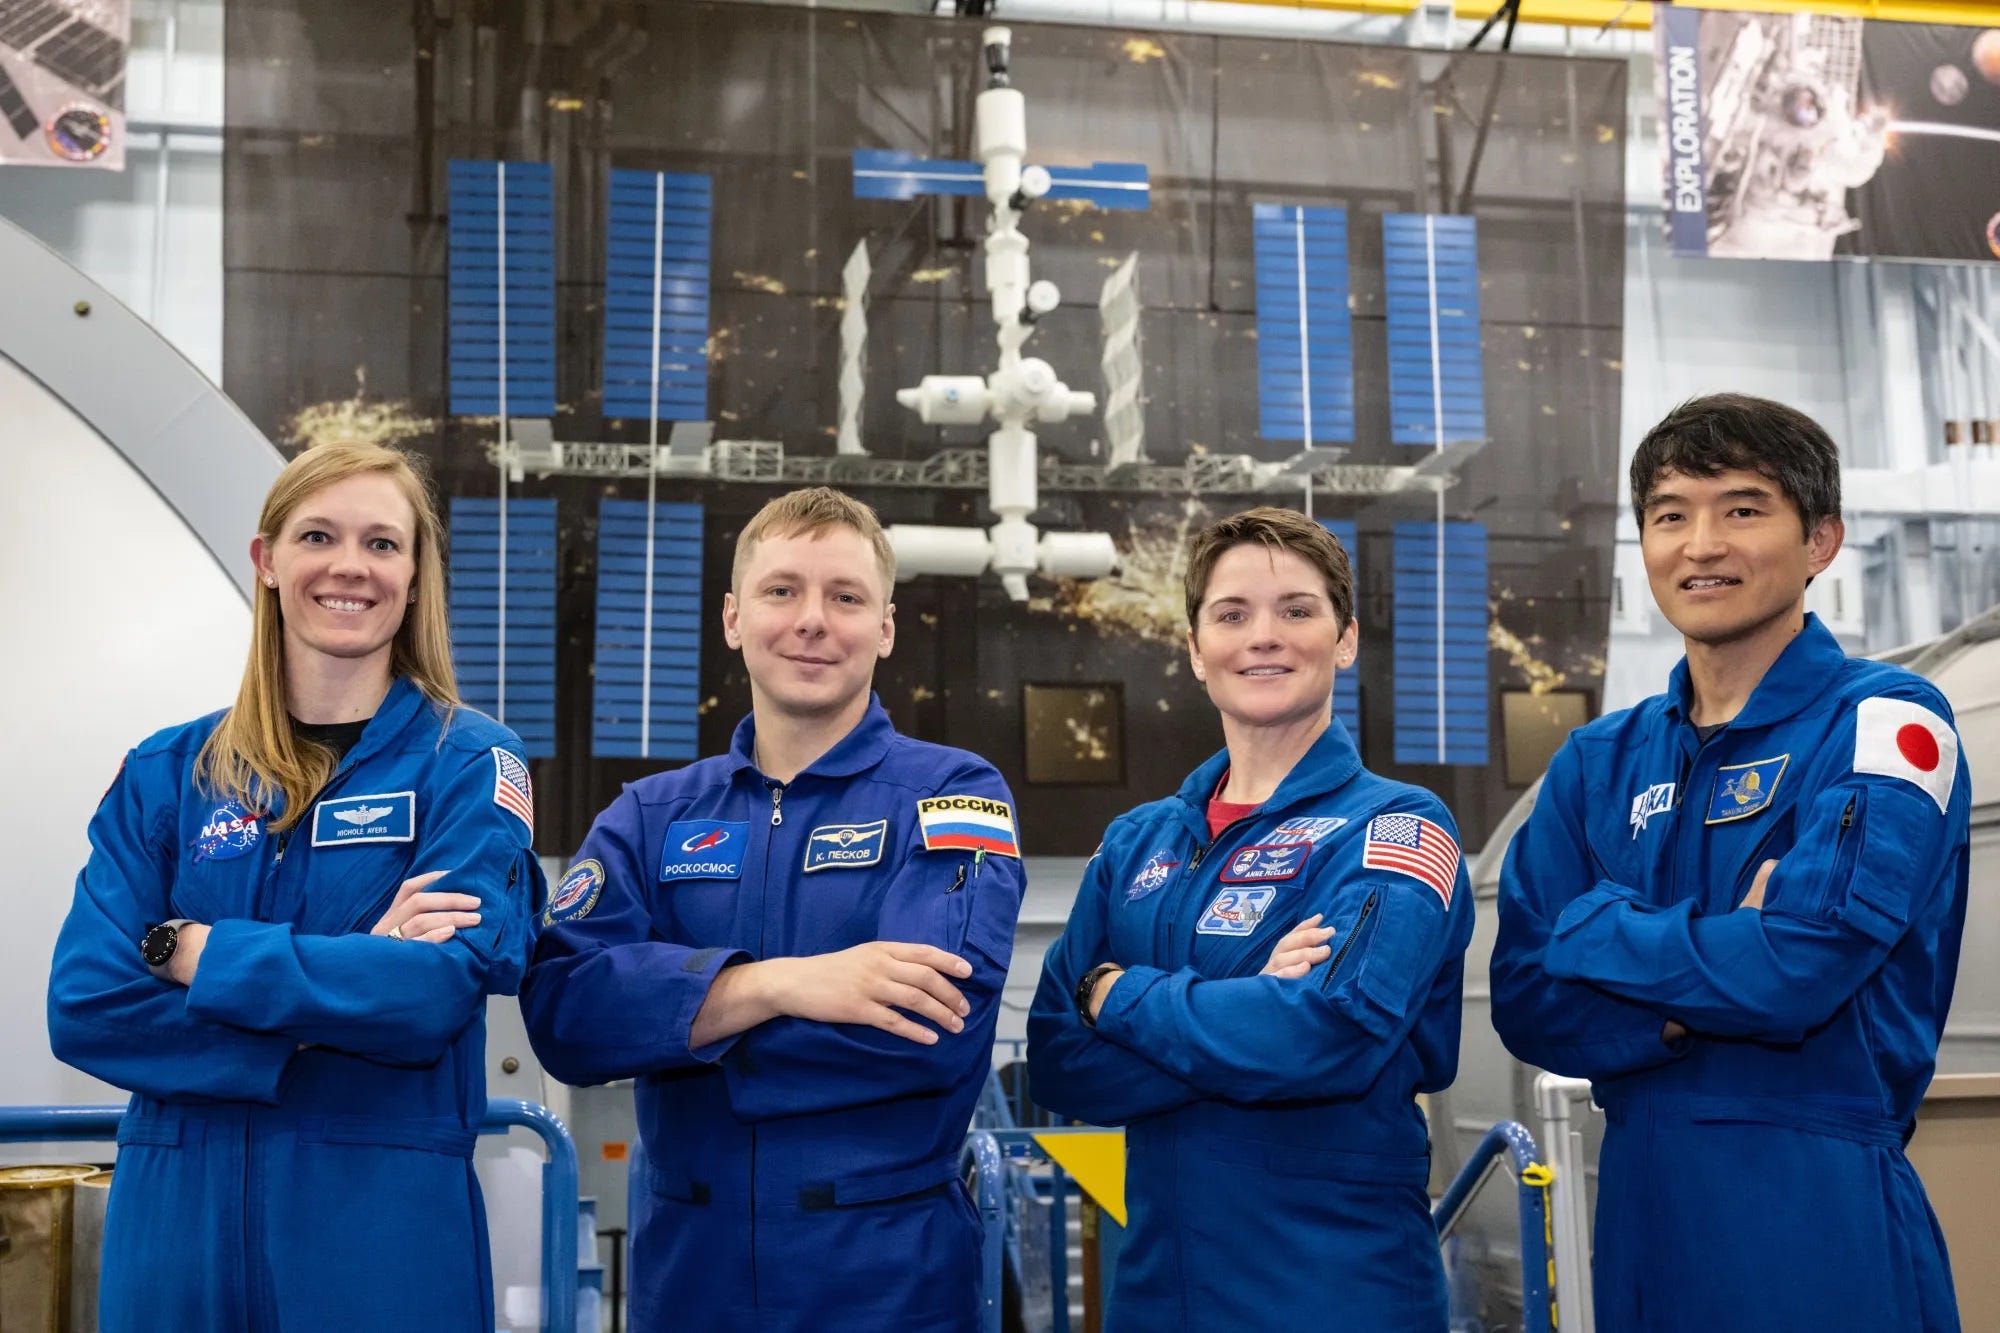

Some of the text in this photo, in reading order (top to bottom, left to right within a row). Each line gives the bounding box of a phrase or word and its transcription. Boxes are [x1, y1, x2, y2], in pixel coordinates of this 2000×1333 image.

[1669, 46, 1702, 212] EXPLORATION
[922, 798, 1008, 818] РОССИЯ
[200, 818, 260, 839] NASA
[336, 826, 388, 838] NICHOLE AYERS
[815, 849, 871, 862] К. ПЕСКОВ
[665, 862, 737, 876] РОСКОСМОС
[1133, 865, 1169, 886] NASA
[1245, 870, 1264, 878] ANNE
